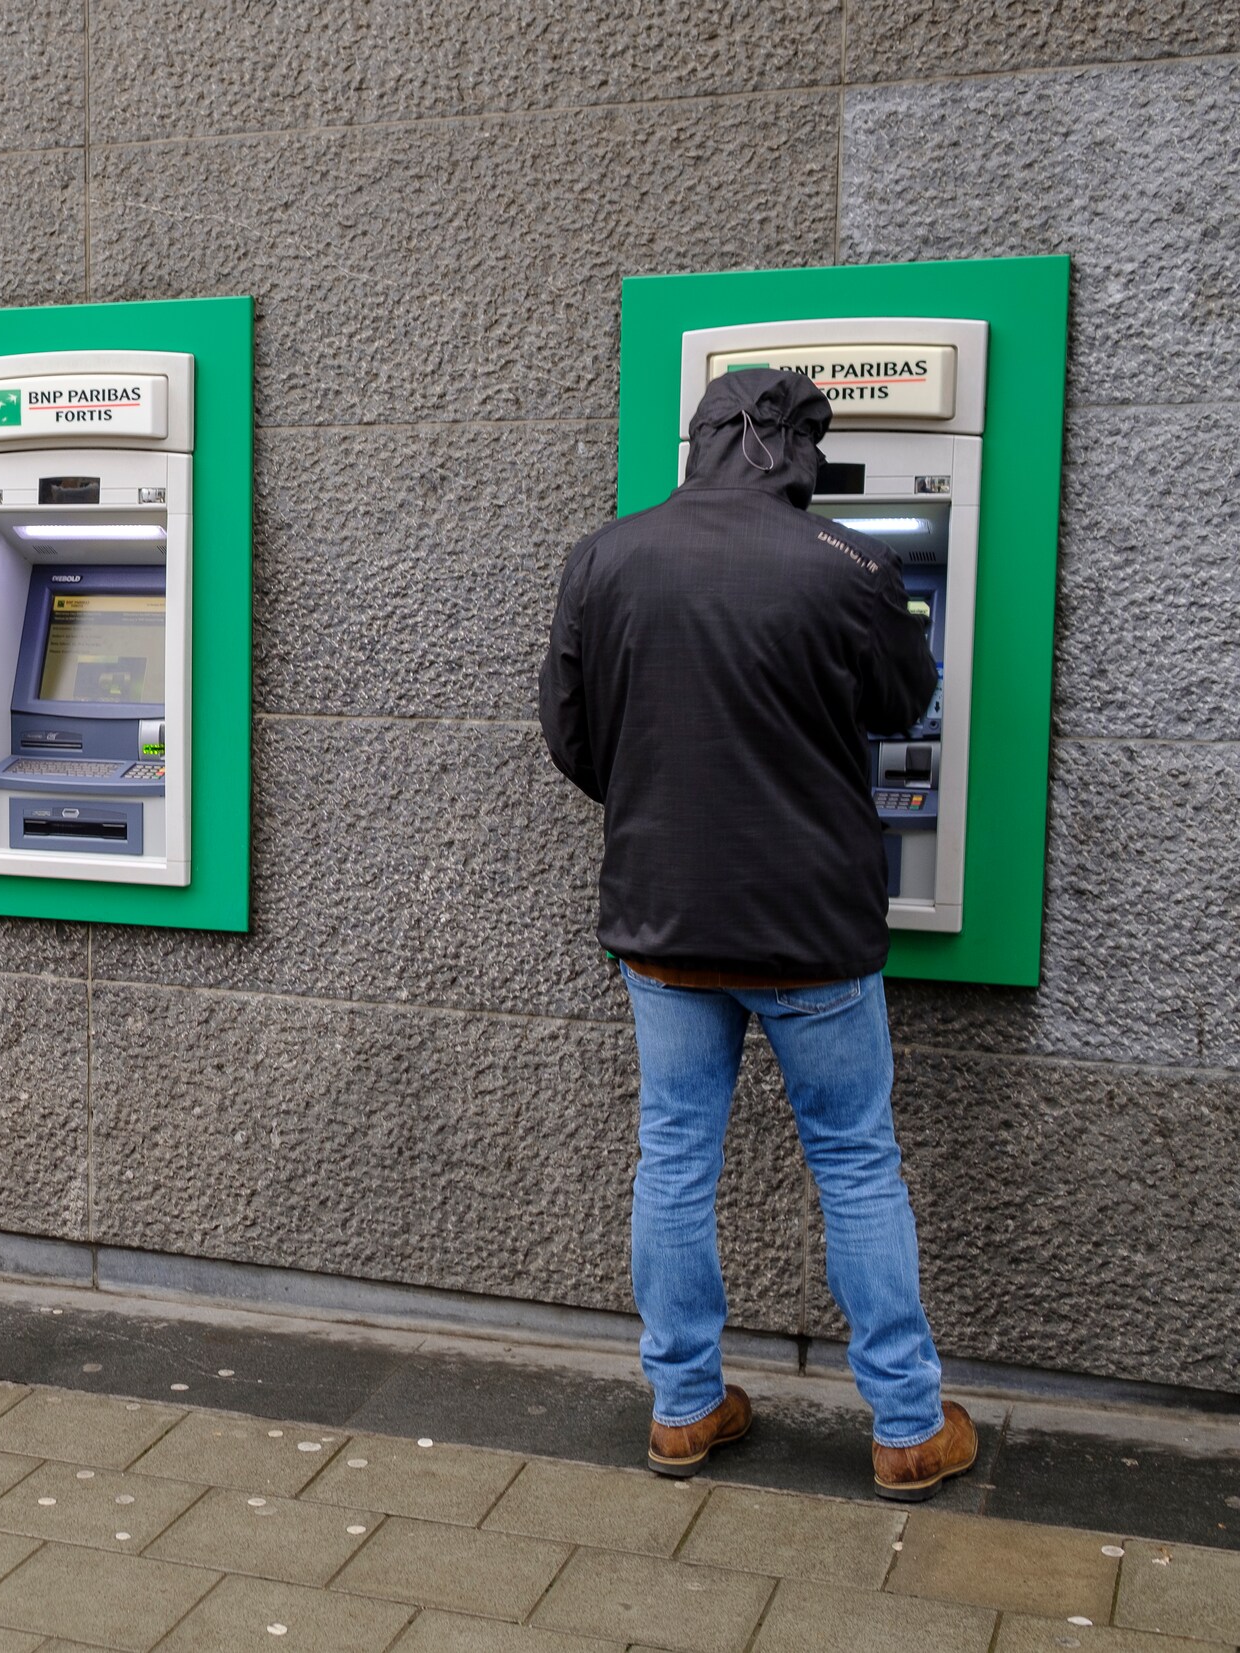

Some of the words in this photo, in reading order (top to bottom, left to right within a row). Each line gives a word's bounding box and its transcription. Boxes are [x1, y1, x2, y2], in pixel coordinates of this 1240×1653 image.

[831, 360, 928, 379] PARIBAS
[28, 390, 63, 404] BNP
[68, 387, 141, 403] PARIBAS
[818, 385, 889, 401] ORTIS
[55, 409, 113, 422] FORTIS
[52, 575, 81, 583] DIEBOLD
